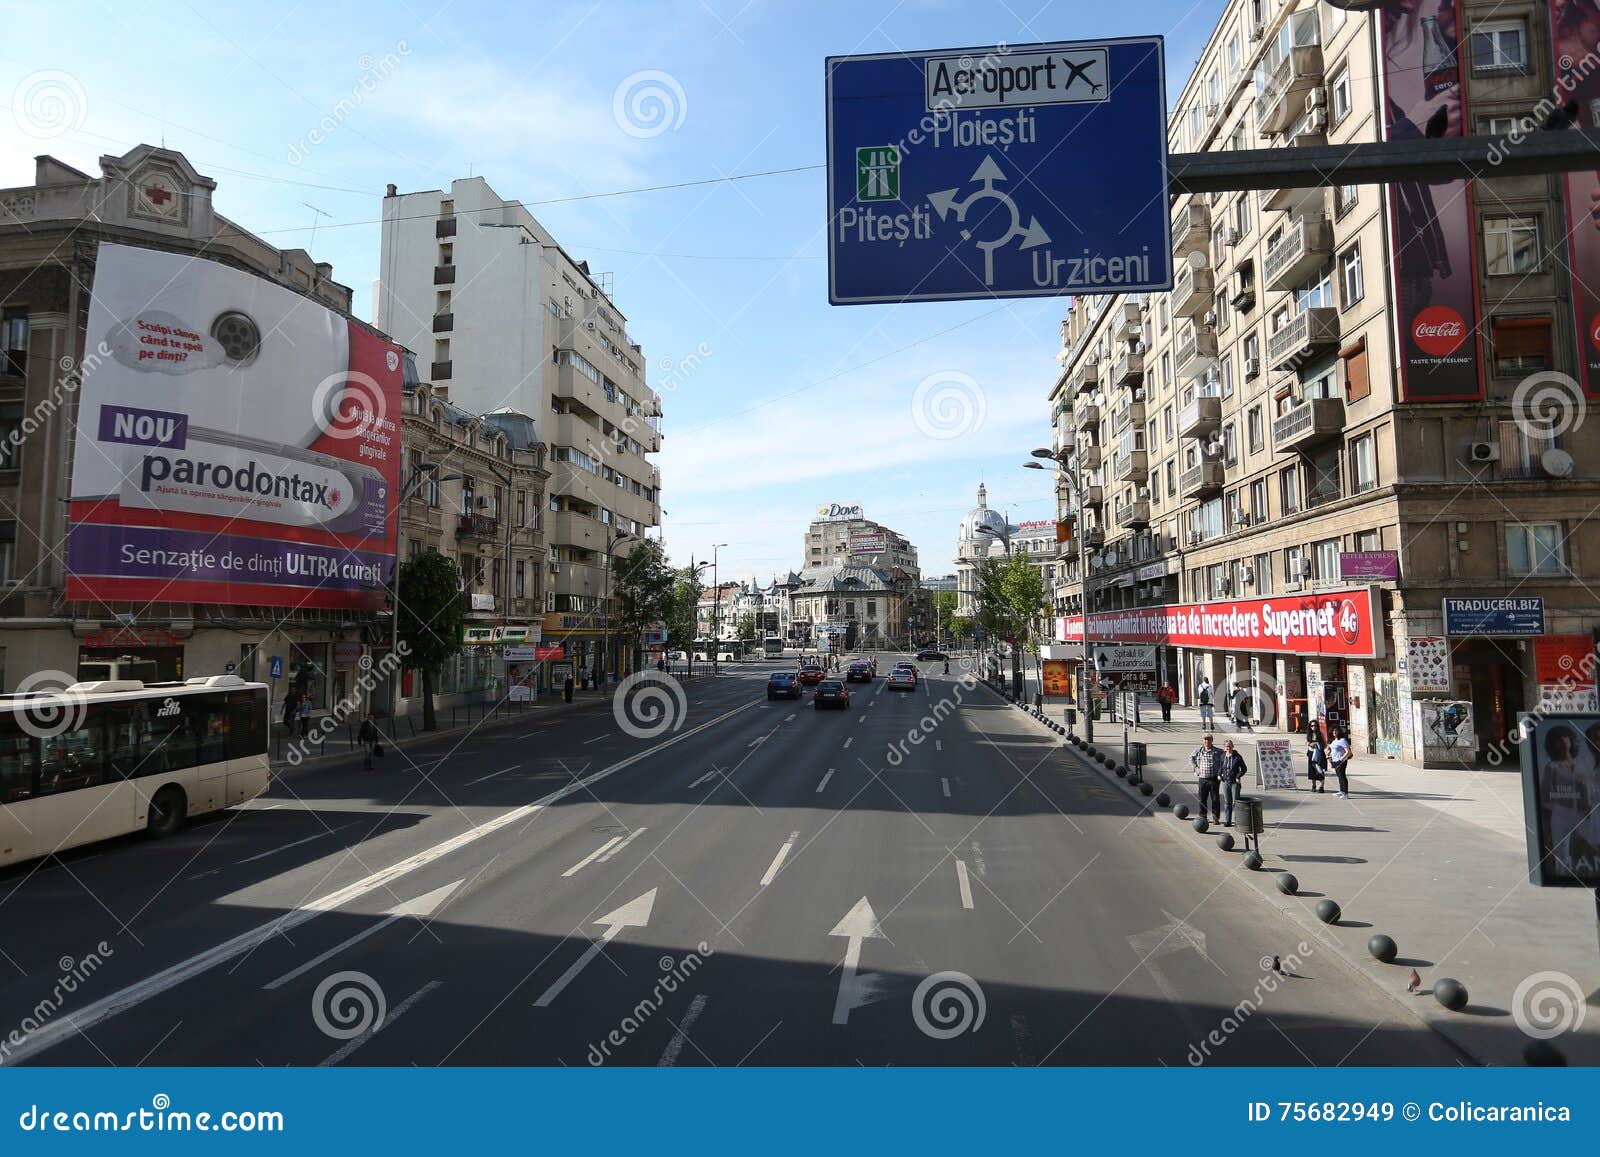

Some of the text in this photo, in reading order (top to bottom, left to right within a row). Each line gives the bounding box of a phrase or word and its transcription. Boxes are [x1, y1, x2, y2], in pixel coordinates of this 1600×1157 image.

[932, 56, 1057, 103] Aeroport
[1032, 245, 1149, 287] Urziceni
[139, 349, 154, 361] pe
[140, 335, 168, 346] când
[170, 339, 181, 348] te
[113, 411, 175, 443] NOU
[141, 454, 332, 510] parodontax
[829, 503, 859, 517] Dove
[220, 551, 244, 571] de
[286, 552, 339, 579] ULTRA
[1448, 599, 1540, 611] TRADUCERI.BIZ
[1177, 610, 1188, 635] ta
[1188, 607, 1200, 635] de
[1201, 605, 1260, 638] încredere
[1262, 601, 1336, 645] Supernet
[1340, 605, 1357, 633] 4G
[1121, 671, 1137, 681] Gara
